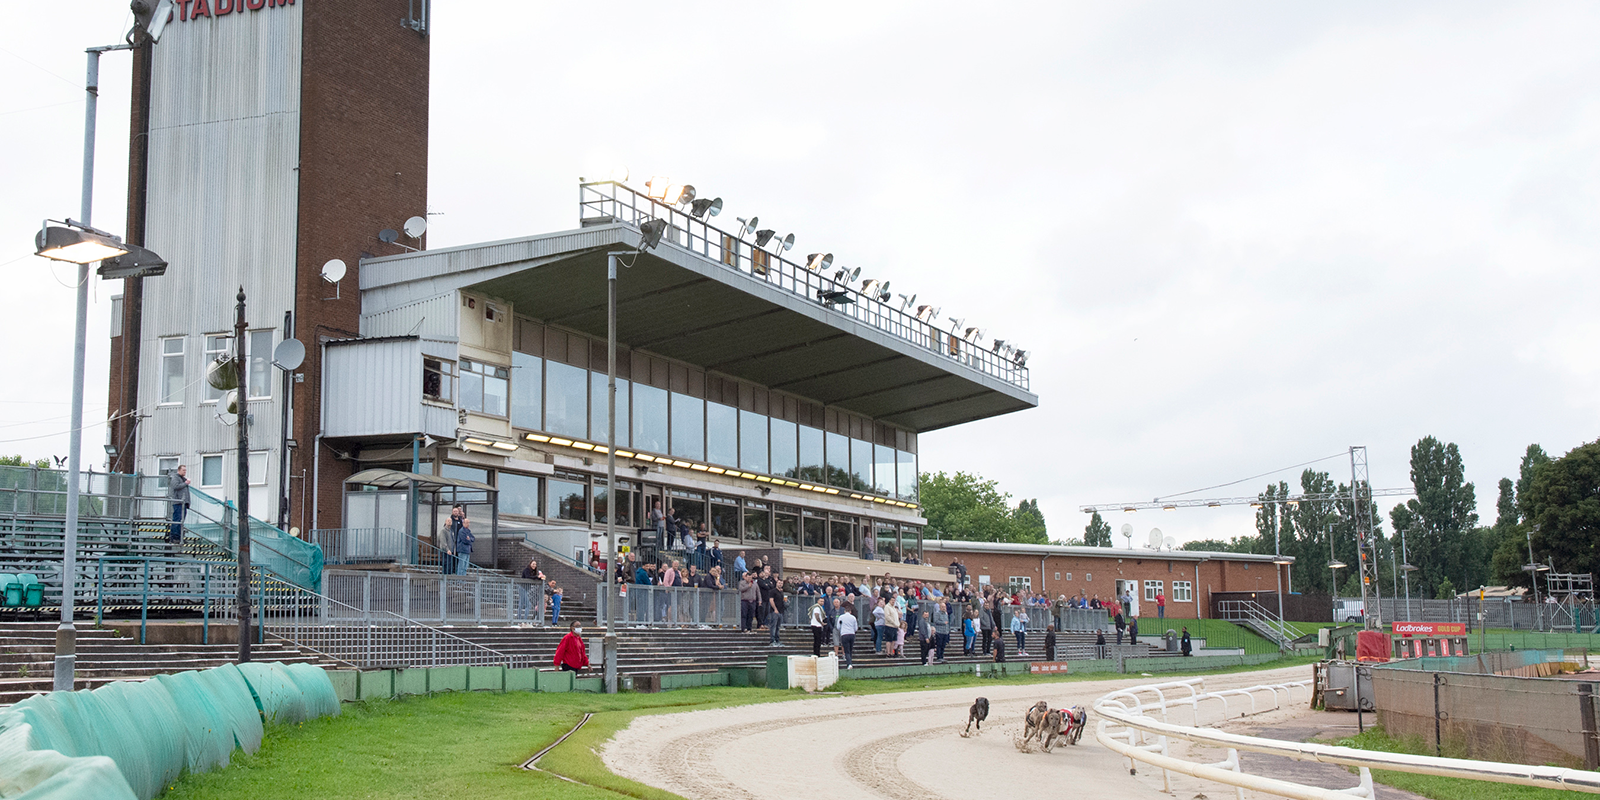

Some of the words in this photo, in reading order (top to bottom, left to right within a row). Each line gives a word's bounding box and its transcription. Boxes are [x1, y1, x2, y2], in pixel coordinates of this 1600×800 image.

[166, 0, 296, 22] TADI
[1396, 624, 1433, 633] Ladbrokes
[1437, 625, 1450, 633] GOLD
[1451, 625, 1461, 633] CUP
